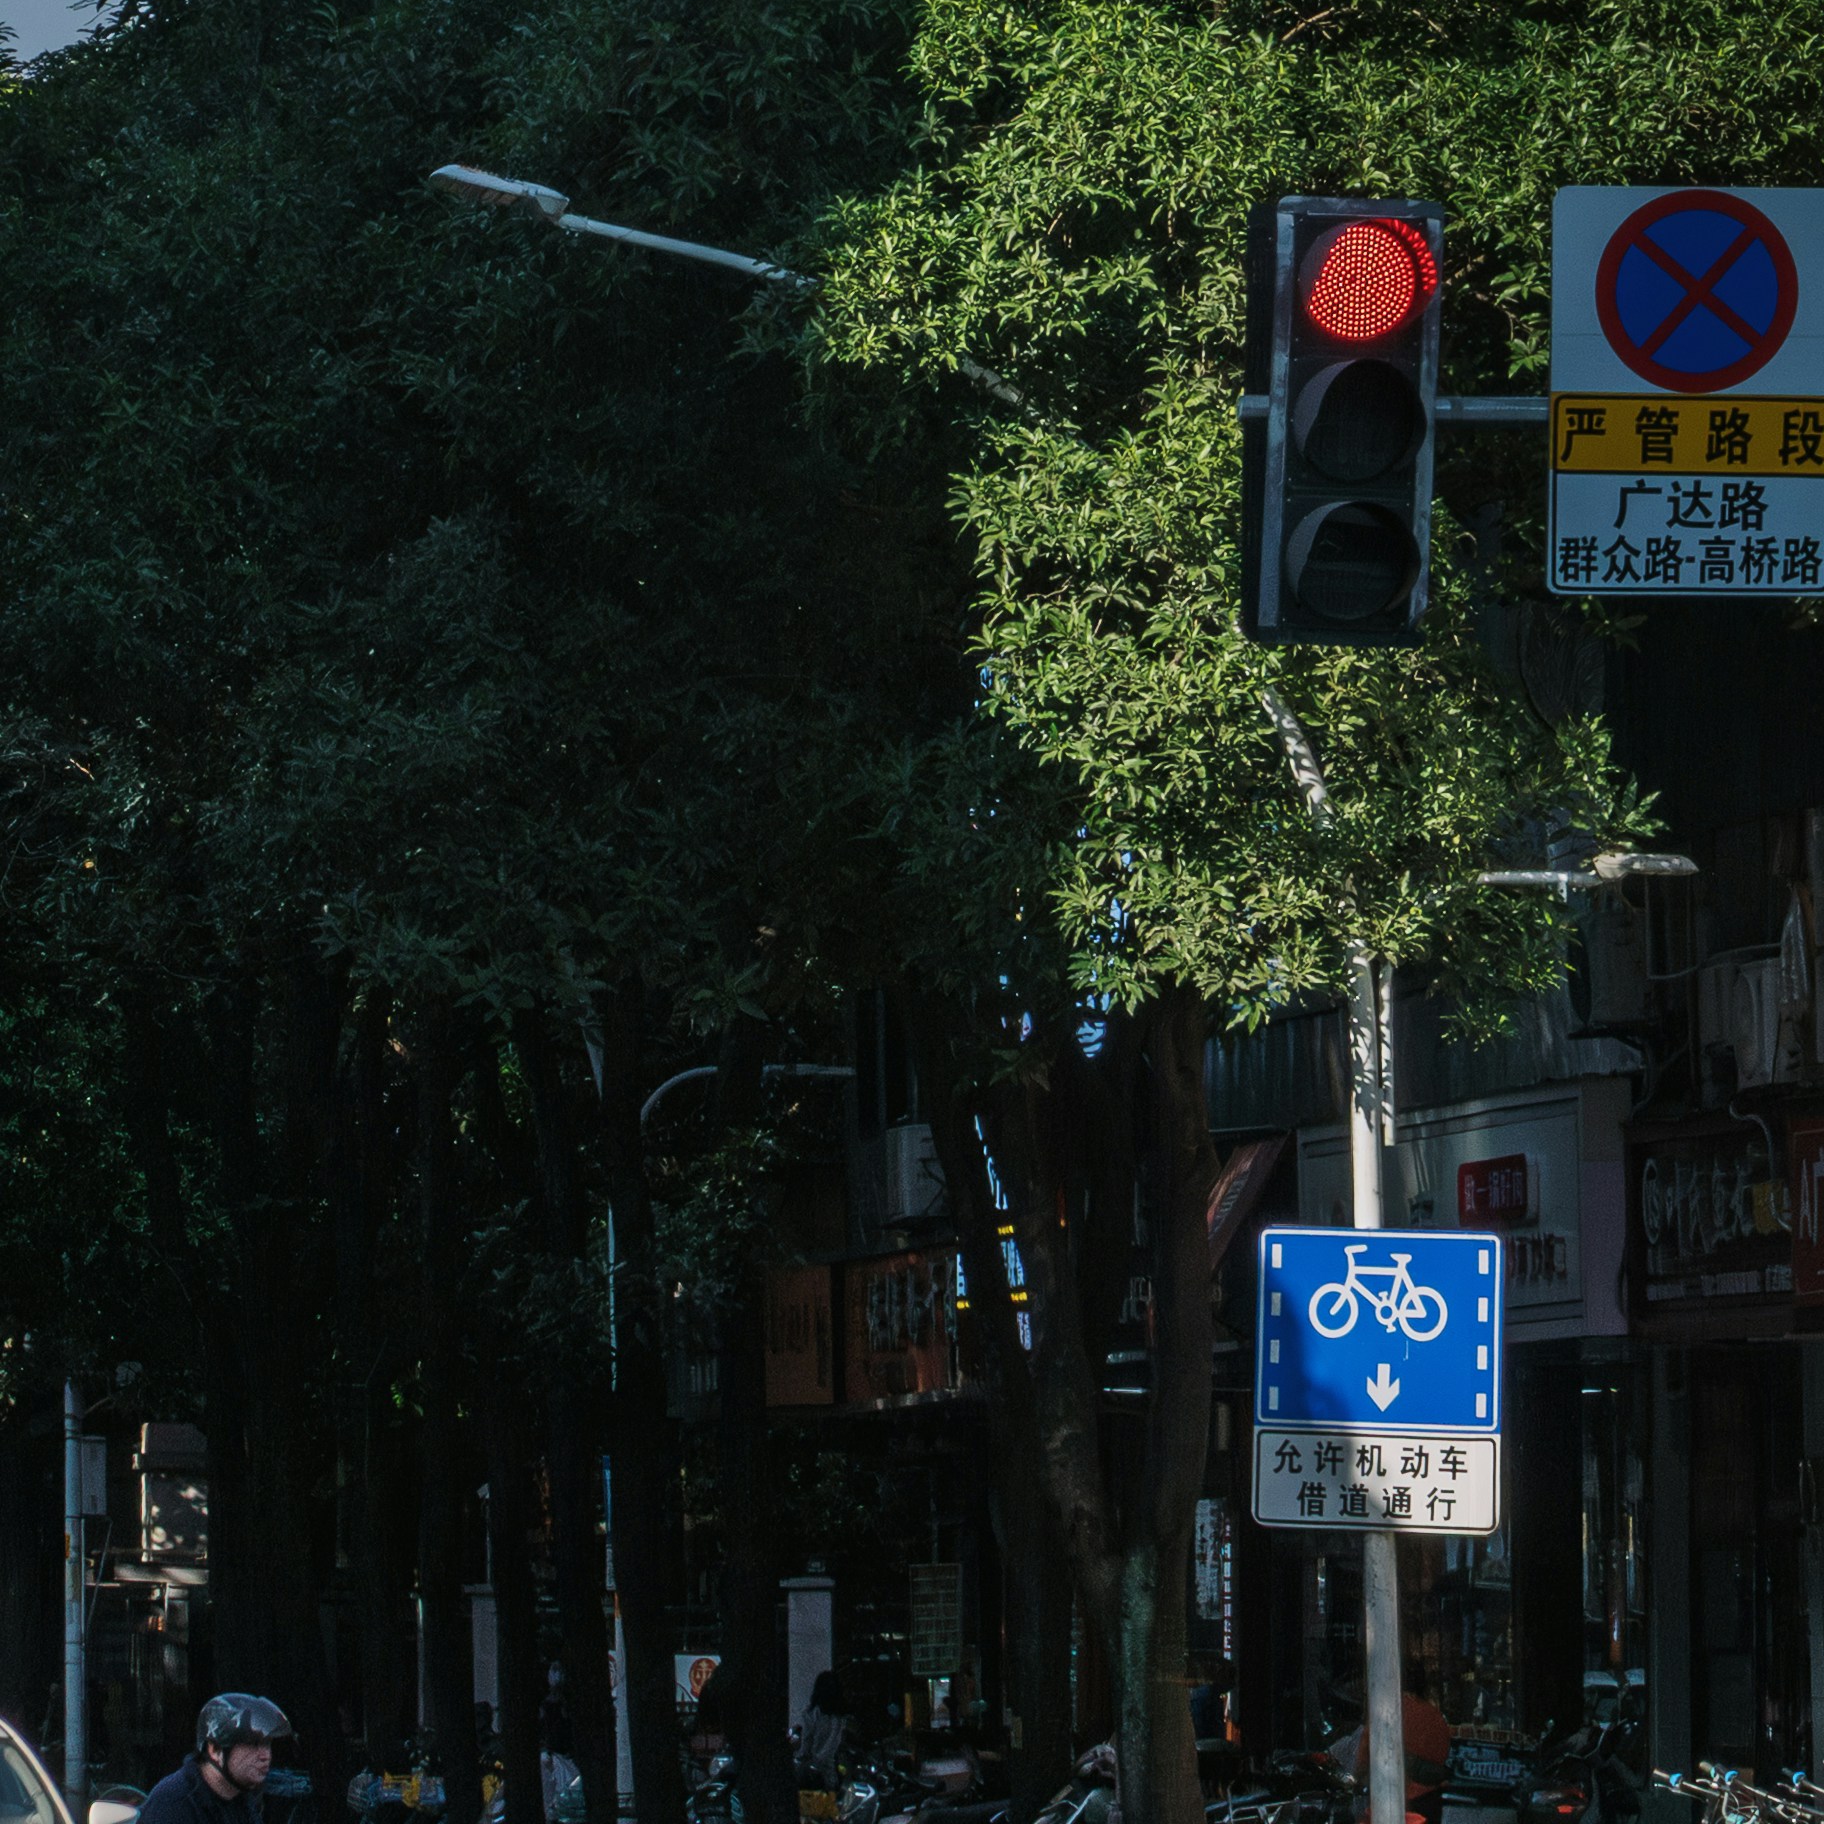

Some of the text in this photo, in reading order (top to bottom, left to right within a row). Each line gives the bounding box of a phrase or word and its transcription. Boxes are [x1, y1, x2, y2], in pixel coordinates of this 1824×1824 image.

[1613, 479, 1768, 531] 广达路
[1558, 535, 1823, 586] 群众路-高桥路
[1273, 1439, 1468, 1480] 允许机动车
[1296, 1481, 1456, 1521] 借道通行
